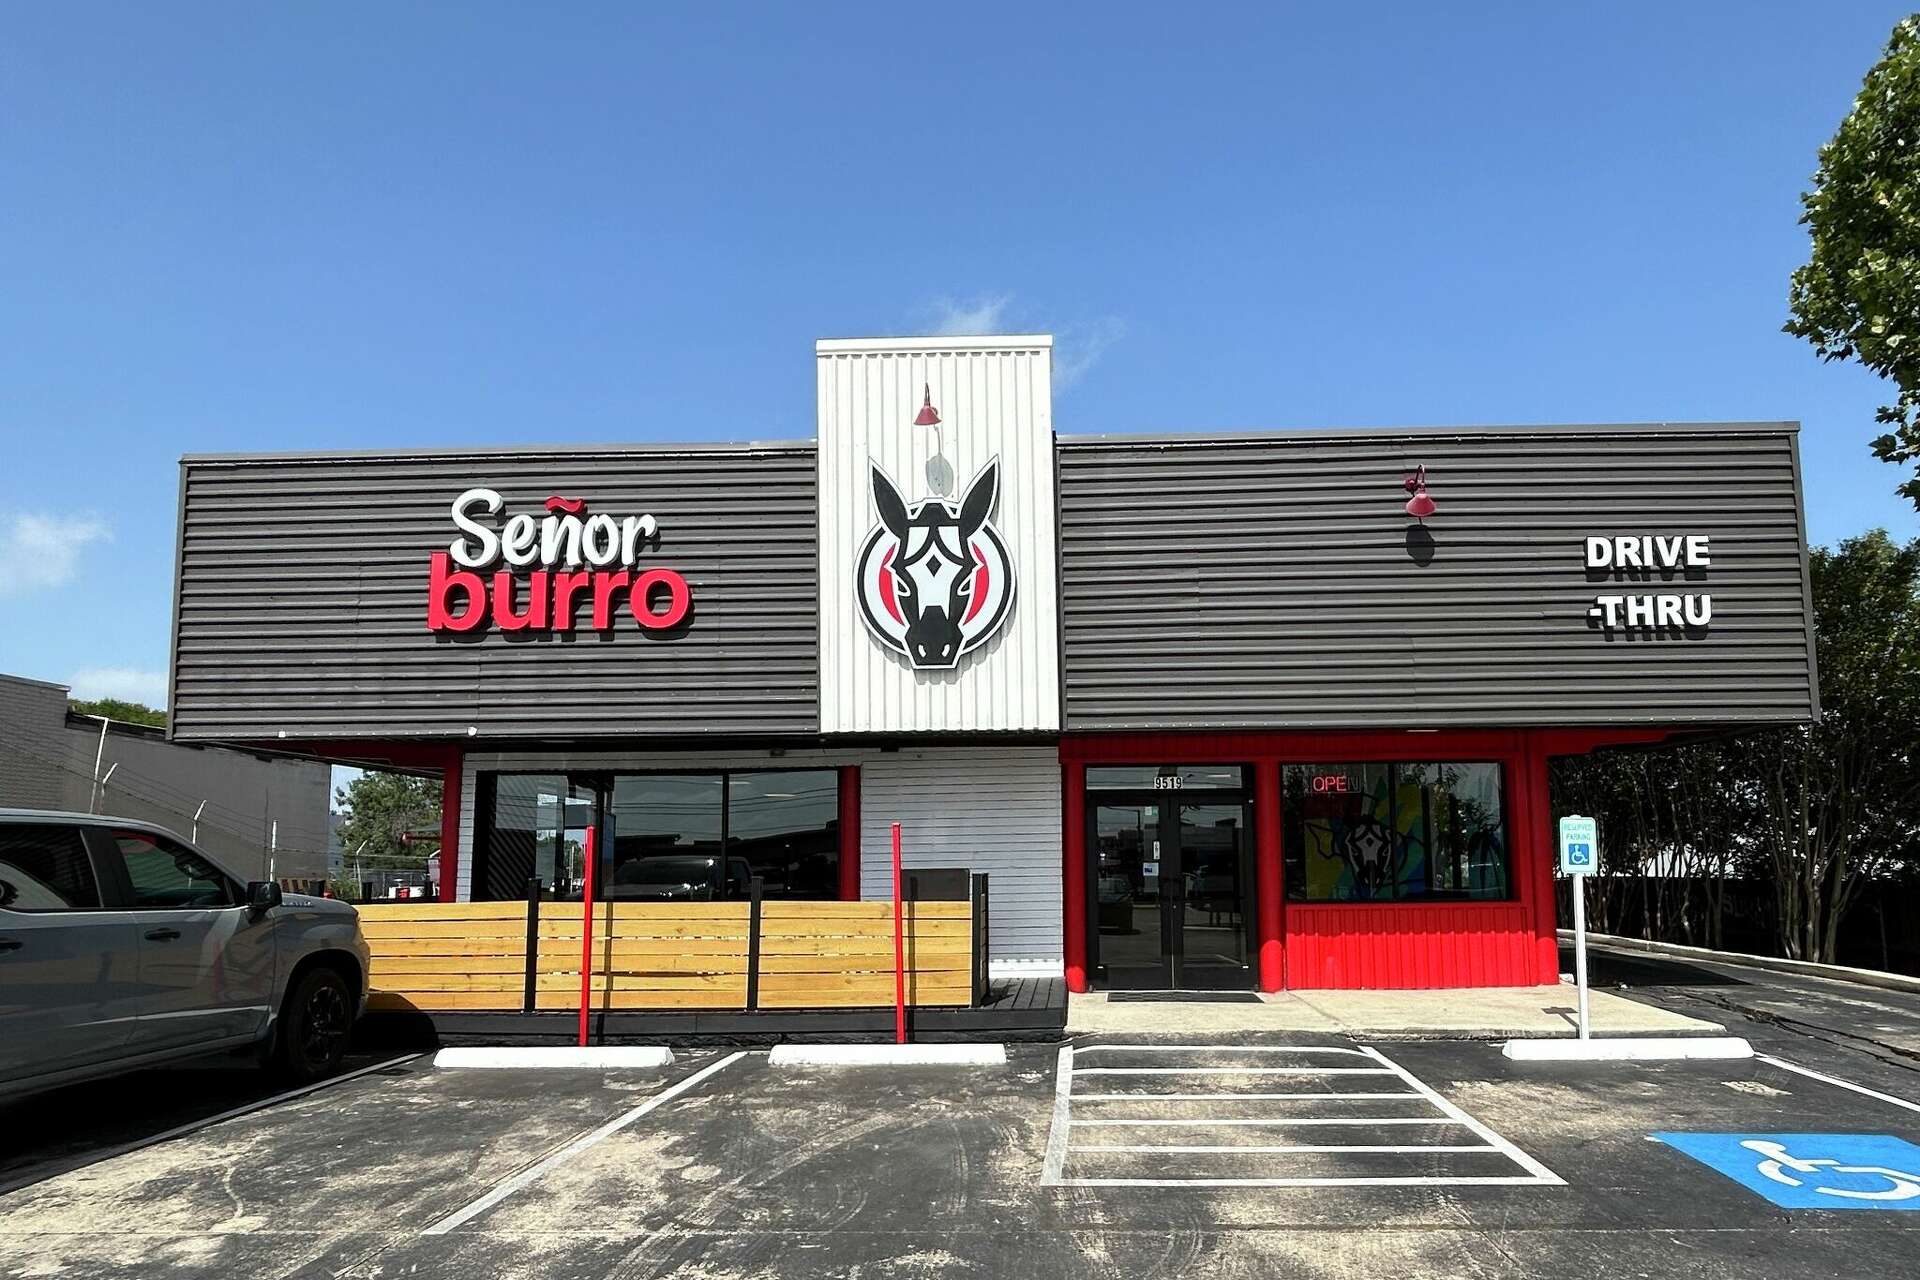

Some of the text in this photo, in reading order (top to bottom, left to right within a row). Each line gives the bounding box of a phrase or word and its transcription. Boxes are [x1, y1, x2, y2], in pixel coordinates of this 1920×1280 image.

[450, 487, 658, 567] Señor
[1585, 535, 1711, 568] DRIVE
[427, 551, 692, 632] burro
[1155, 777, 1182, 789] 9519
[1566, 833, 1591, 841] PARKING
